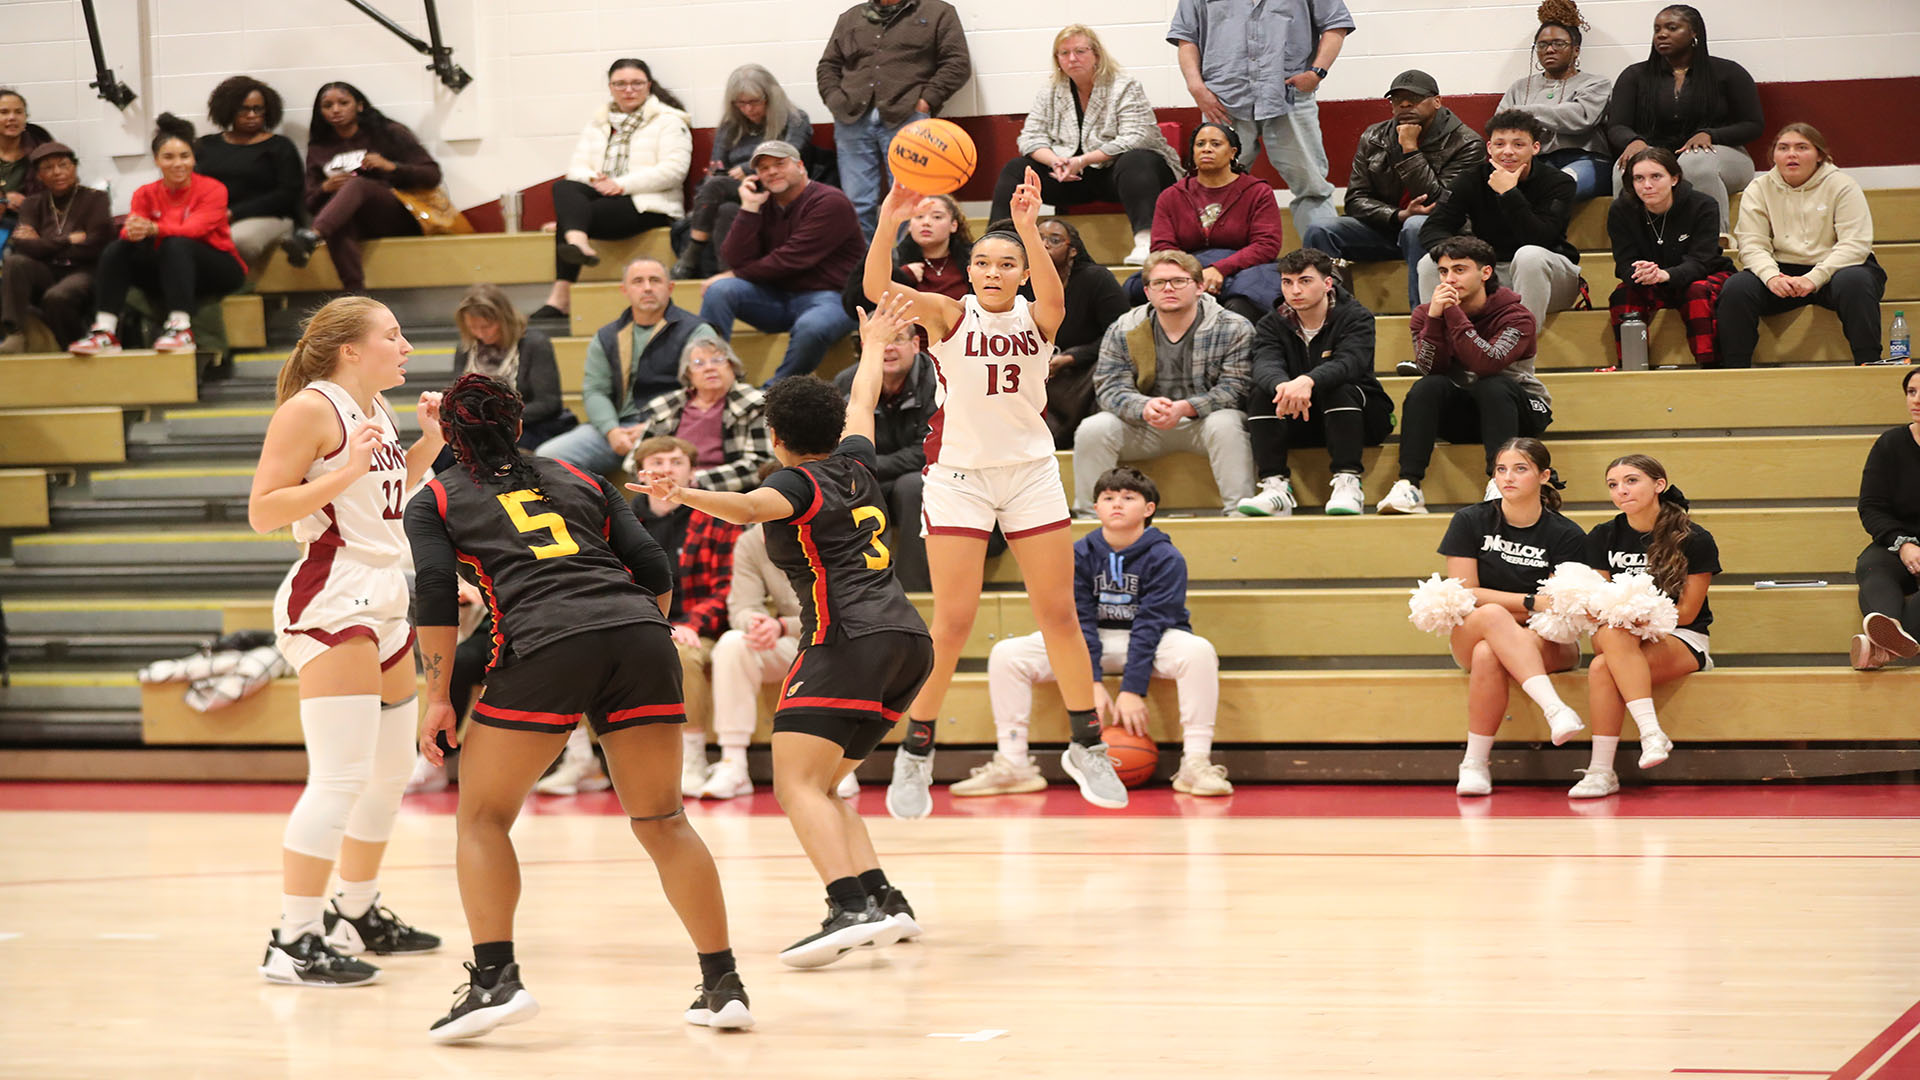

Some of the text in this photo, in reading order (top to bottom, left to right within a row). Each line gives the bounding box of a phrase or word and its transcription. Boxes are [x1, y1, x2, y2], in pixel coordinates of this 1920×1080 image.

[894, 143, 929, 168] NCAA
[964, 330, 1039, 356] LIONS
[985, 363, 1021, 396] 13
[496, 487, 580, 560] 5
[851, 505, 890, 571] 3
[1480, 534, 1547, 560] MOLLOY
[1608, 550, 1652, 568] MOLL
